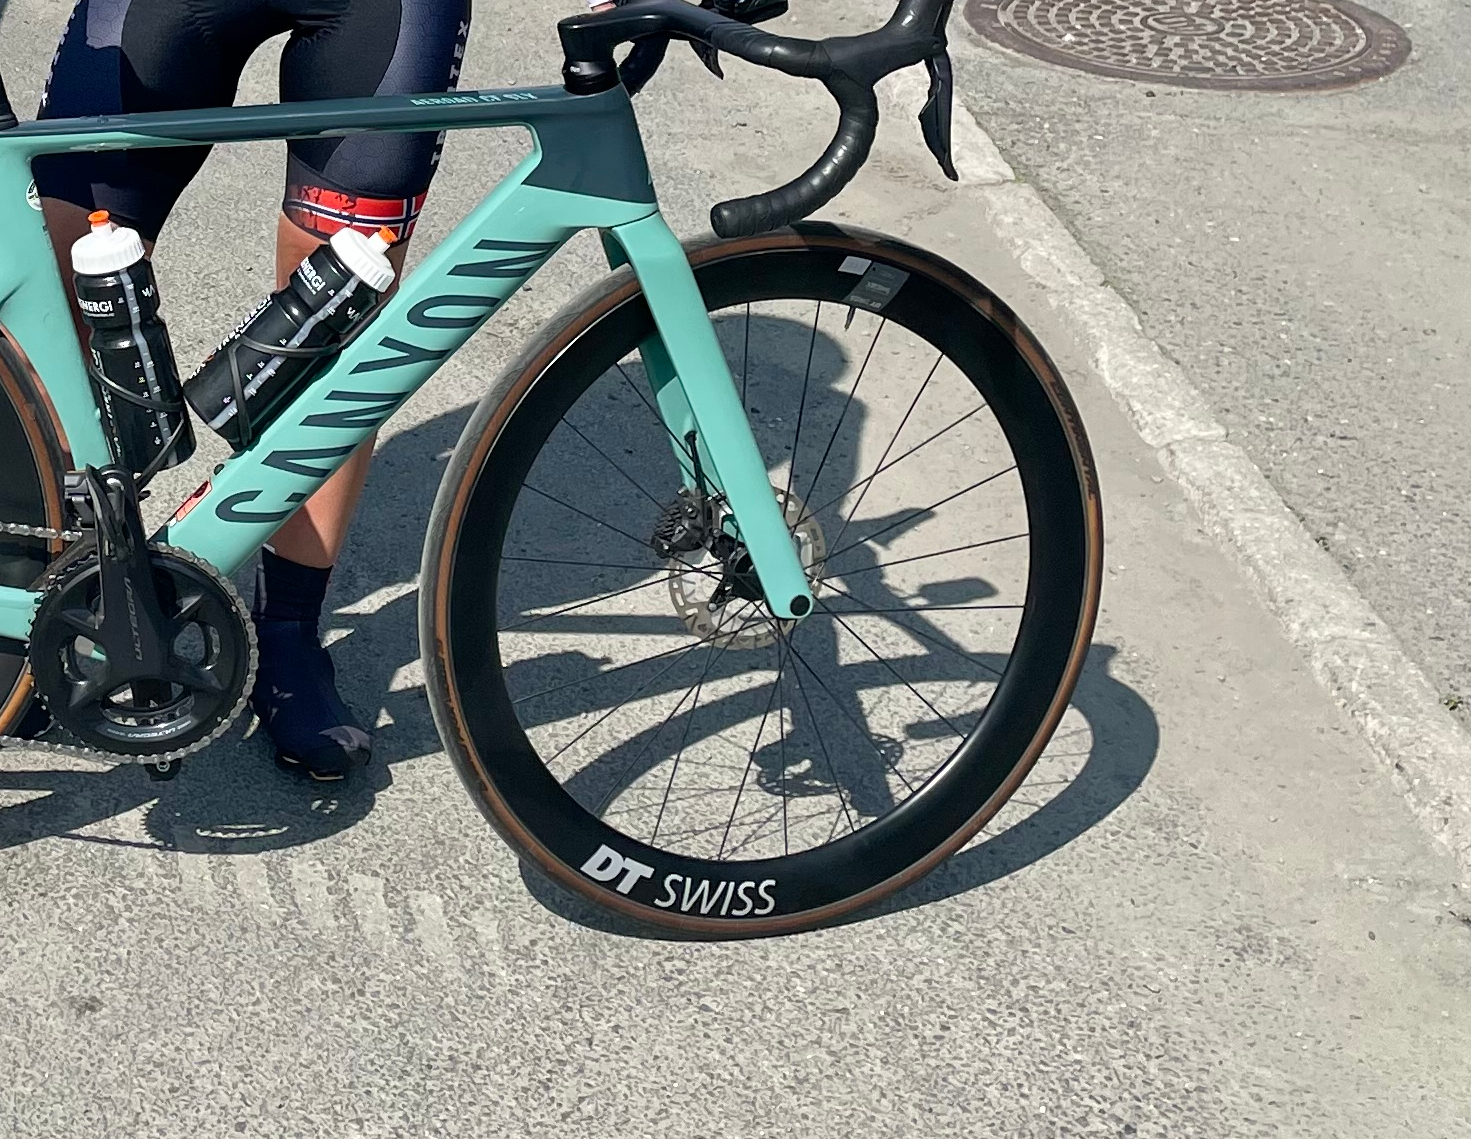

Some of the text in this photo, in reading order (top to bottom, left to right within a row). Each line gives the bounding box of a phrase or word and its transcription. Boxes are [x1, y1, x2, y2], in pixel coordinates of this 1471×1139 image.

[215, 239, 560, 523] CANYON
[580, 844, 776, 916] DT SWISS
